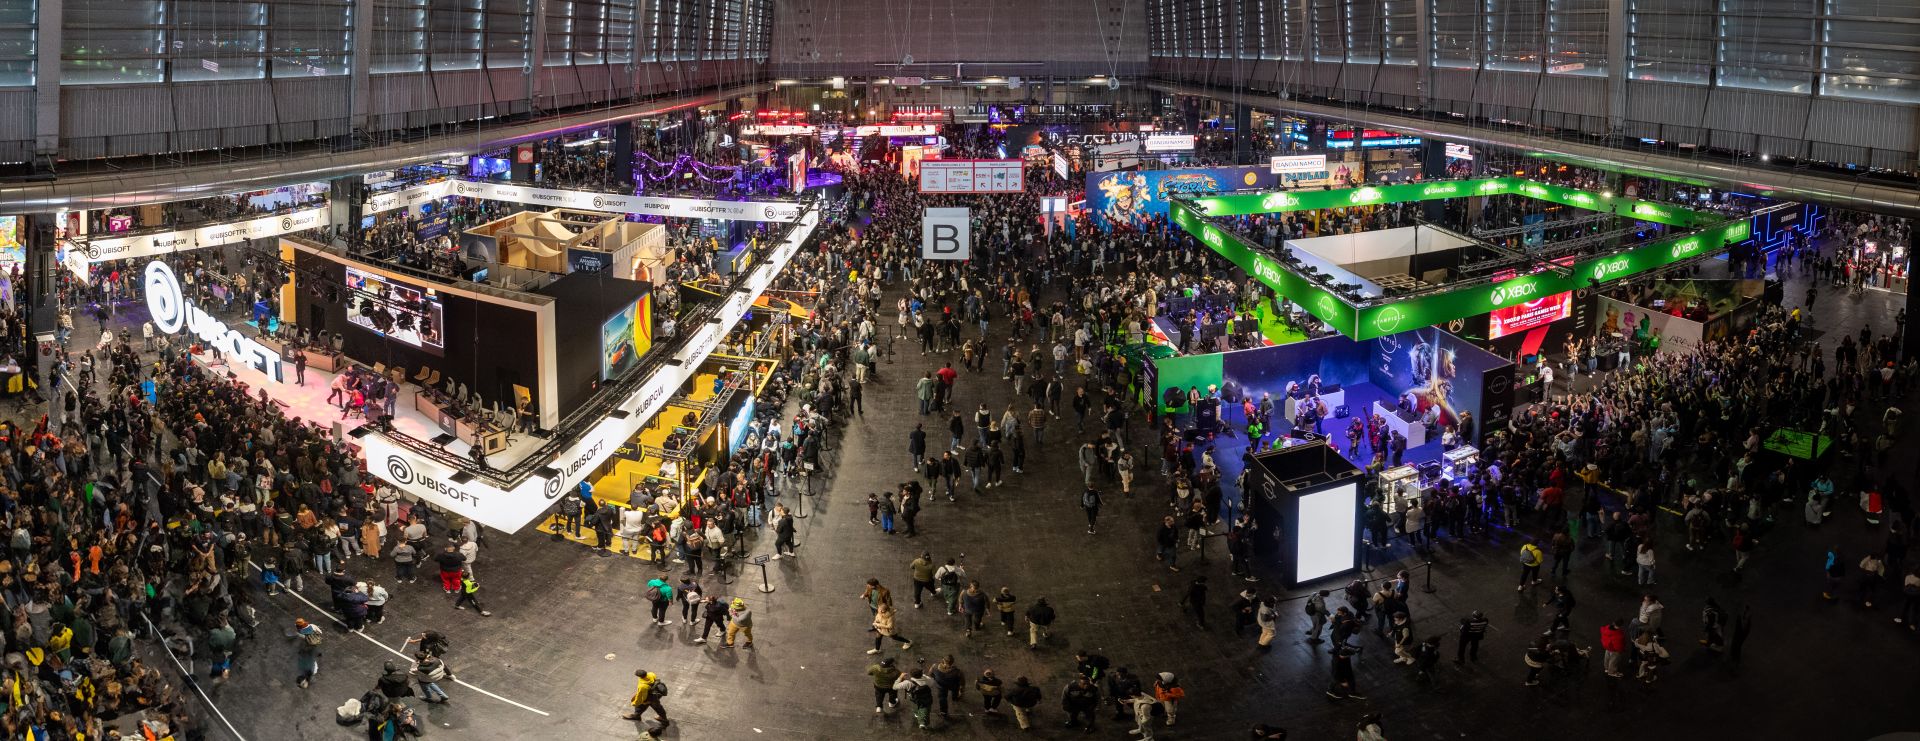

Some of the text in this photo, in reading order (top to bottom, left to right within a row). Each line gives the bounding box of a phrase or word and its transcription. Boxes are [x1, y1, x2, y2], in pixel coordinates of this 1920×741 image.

[644, 202, 671, 210] #UBIPGW
[1657, 210, 1672, 219] PASS
[932, 224, 960, 253] B
[1209, 231, 1223, 248] XBOX
[1681, 240, 1699, 254] XBOX
[102, 245, 131, 255] UBISOFT
[1262, 265, 1281, 286] XBOX
[1606, 259, 1630, 274] XBOX
[1507, 282, 1537, 300] XBOX
[184, 297, 284, 384] UBISOFT
[635, 384, 664, 418] #UBIPGW
[566, 439, 604, 478] UBISOFT
[416, 472, 480, 508] UBISOFT
